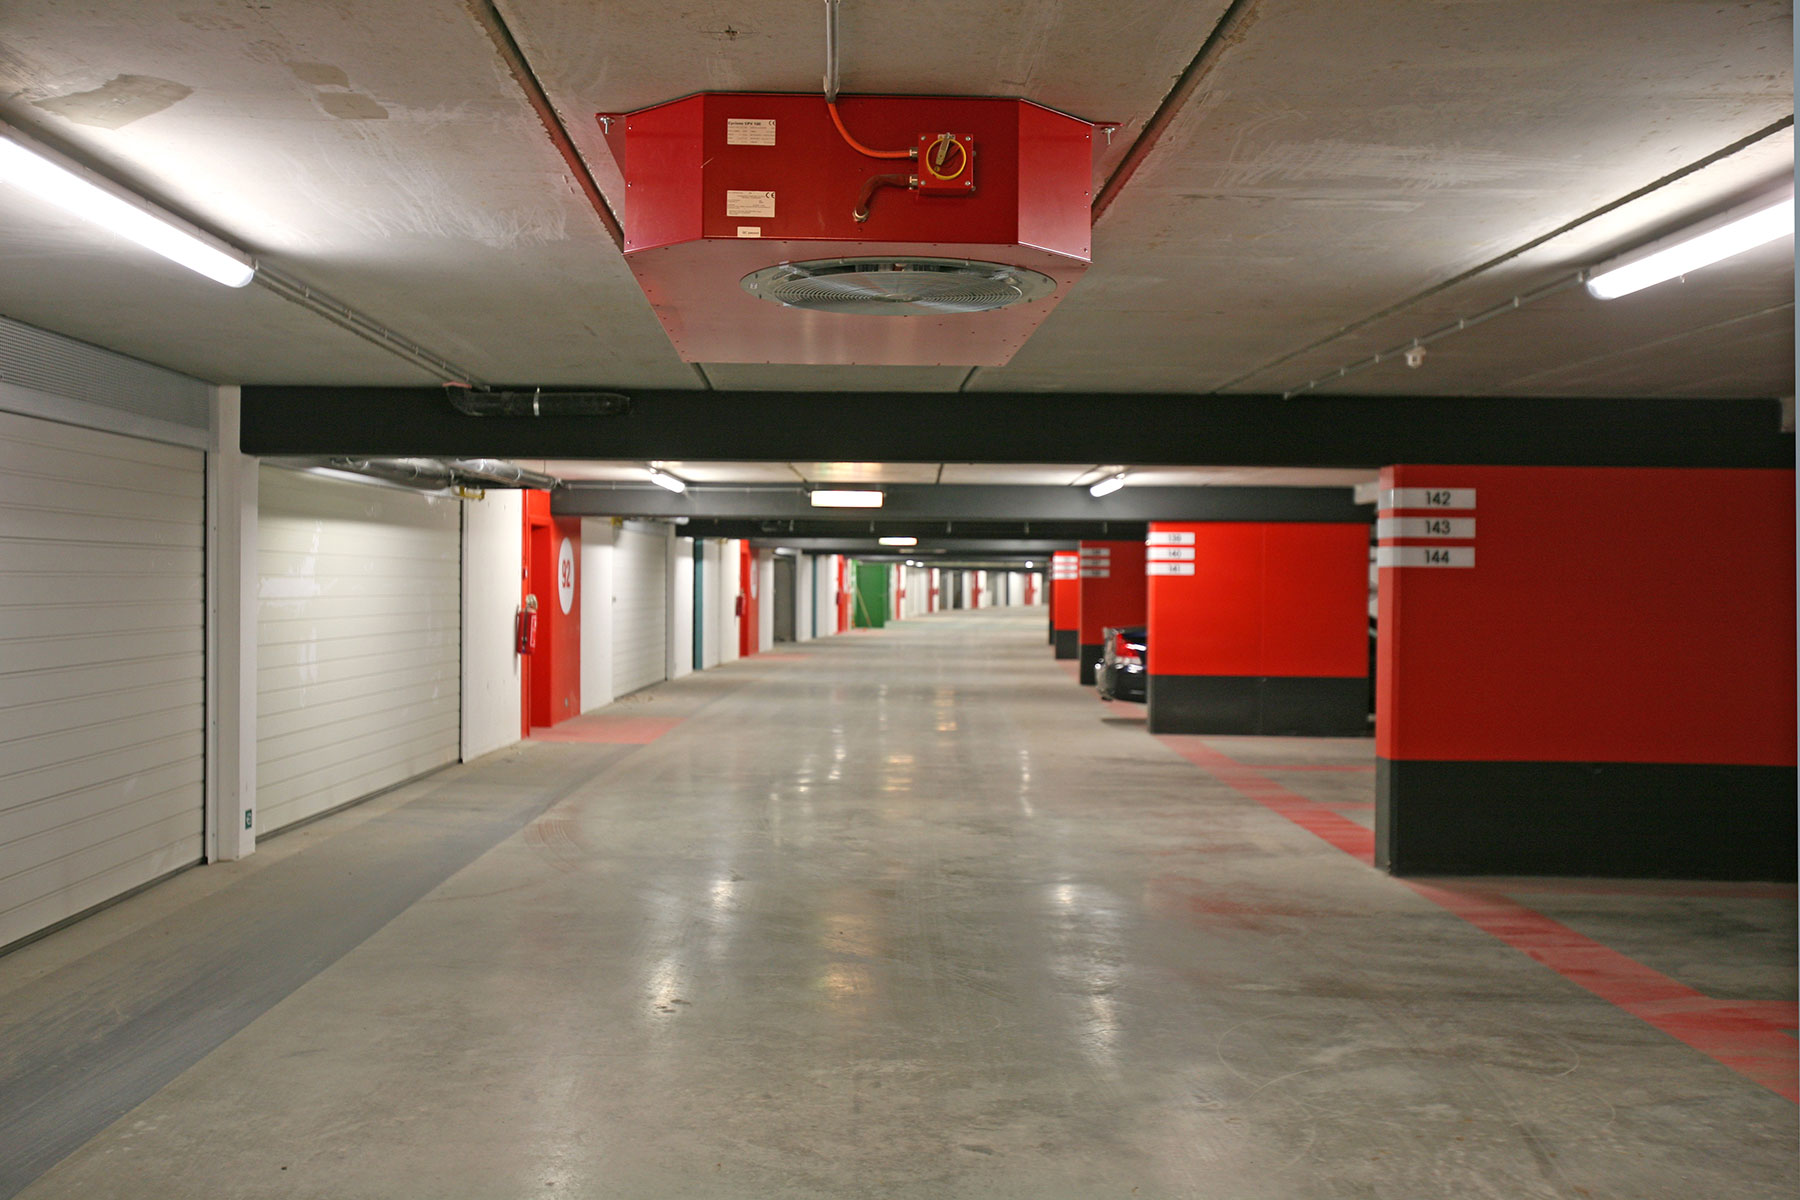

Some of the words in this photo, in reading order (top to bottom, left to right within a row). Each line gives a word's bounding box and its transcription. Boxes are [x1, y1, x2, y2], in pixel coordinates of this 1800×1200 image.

[1425, 491, 1451, 506] 142
[1425, 520, 1451, 535] 143
[1425, 549, 1450, 564] 144
[561, 559, 571, 588] 92
